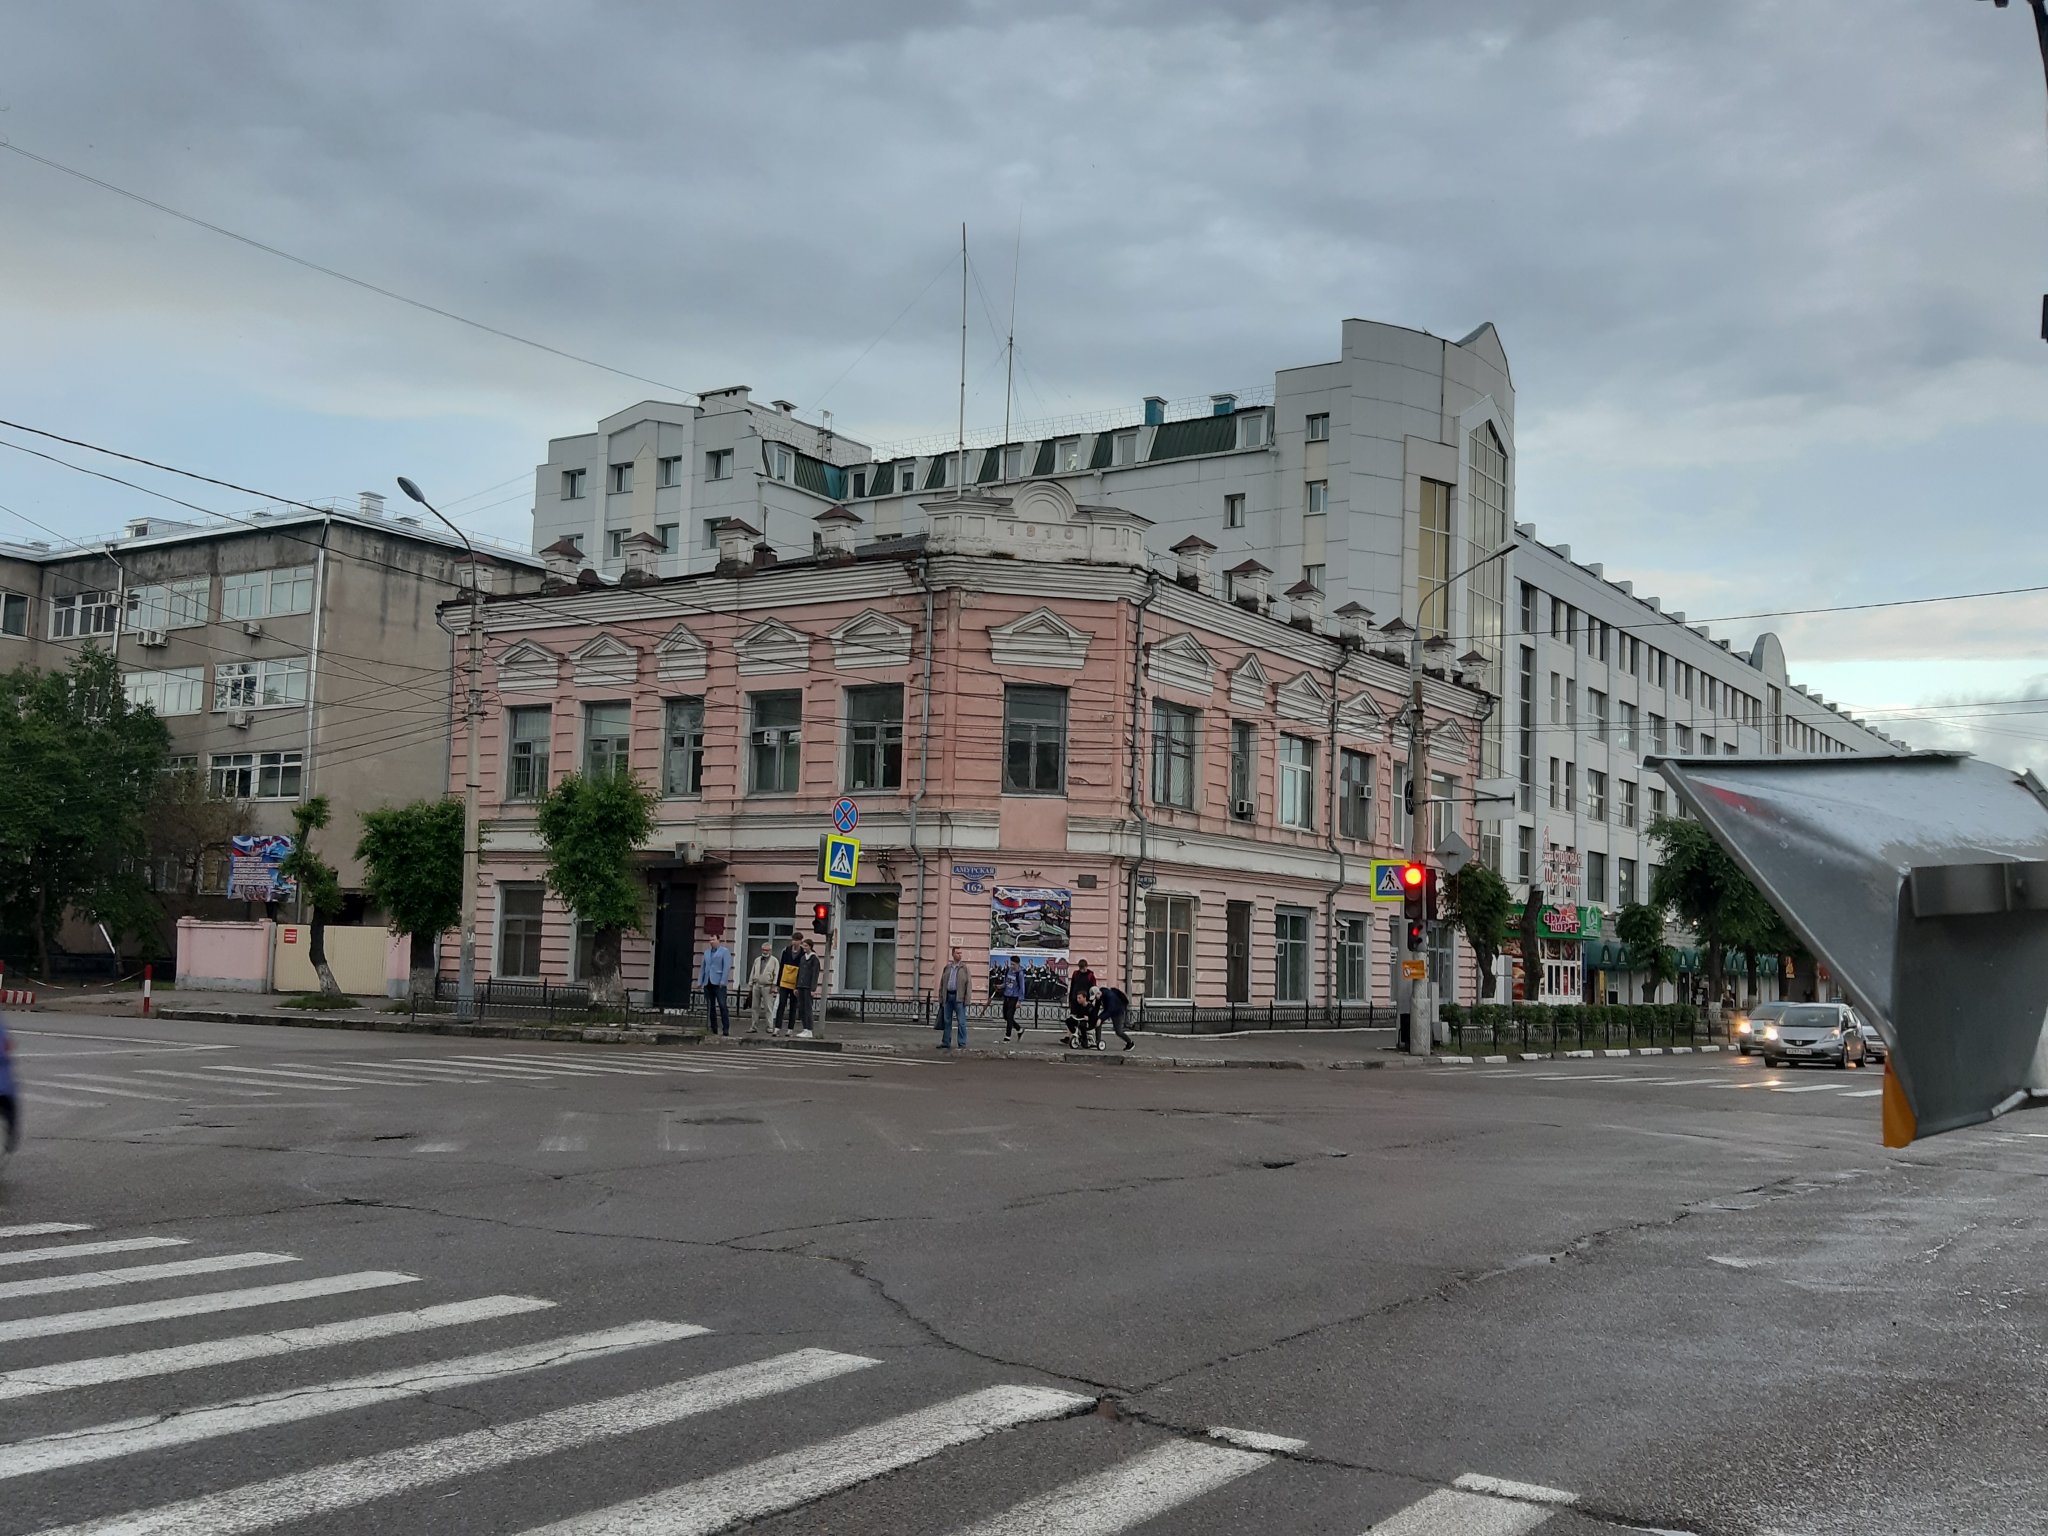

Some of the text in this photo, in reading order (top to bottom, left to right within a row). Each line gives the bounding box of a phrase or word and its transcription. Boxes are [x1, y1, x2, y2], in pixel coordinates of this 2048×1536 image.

[1554, 850, 1582, 866] СТОЛОВАЯ
[955, 866, 995, 874] АМУРСКАЯ
[967, 884, 982, 892] 162
